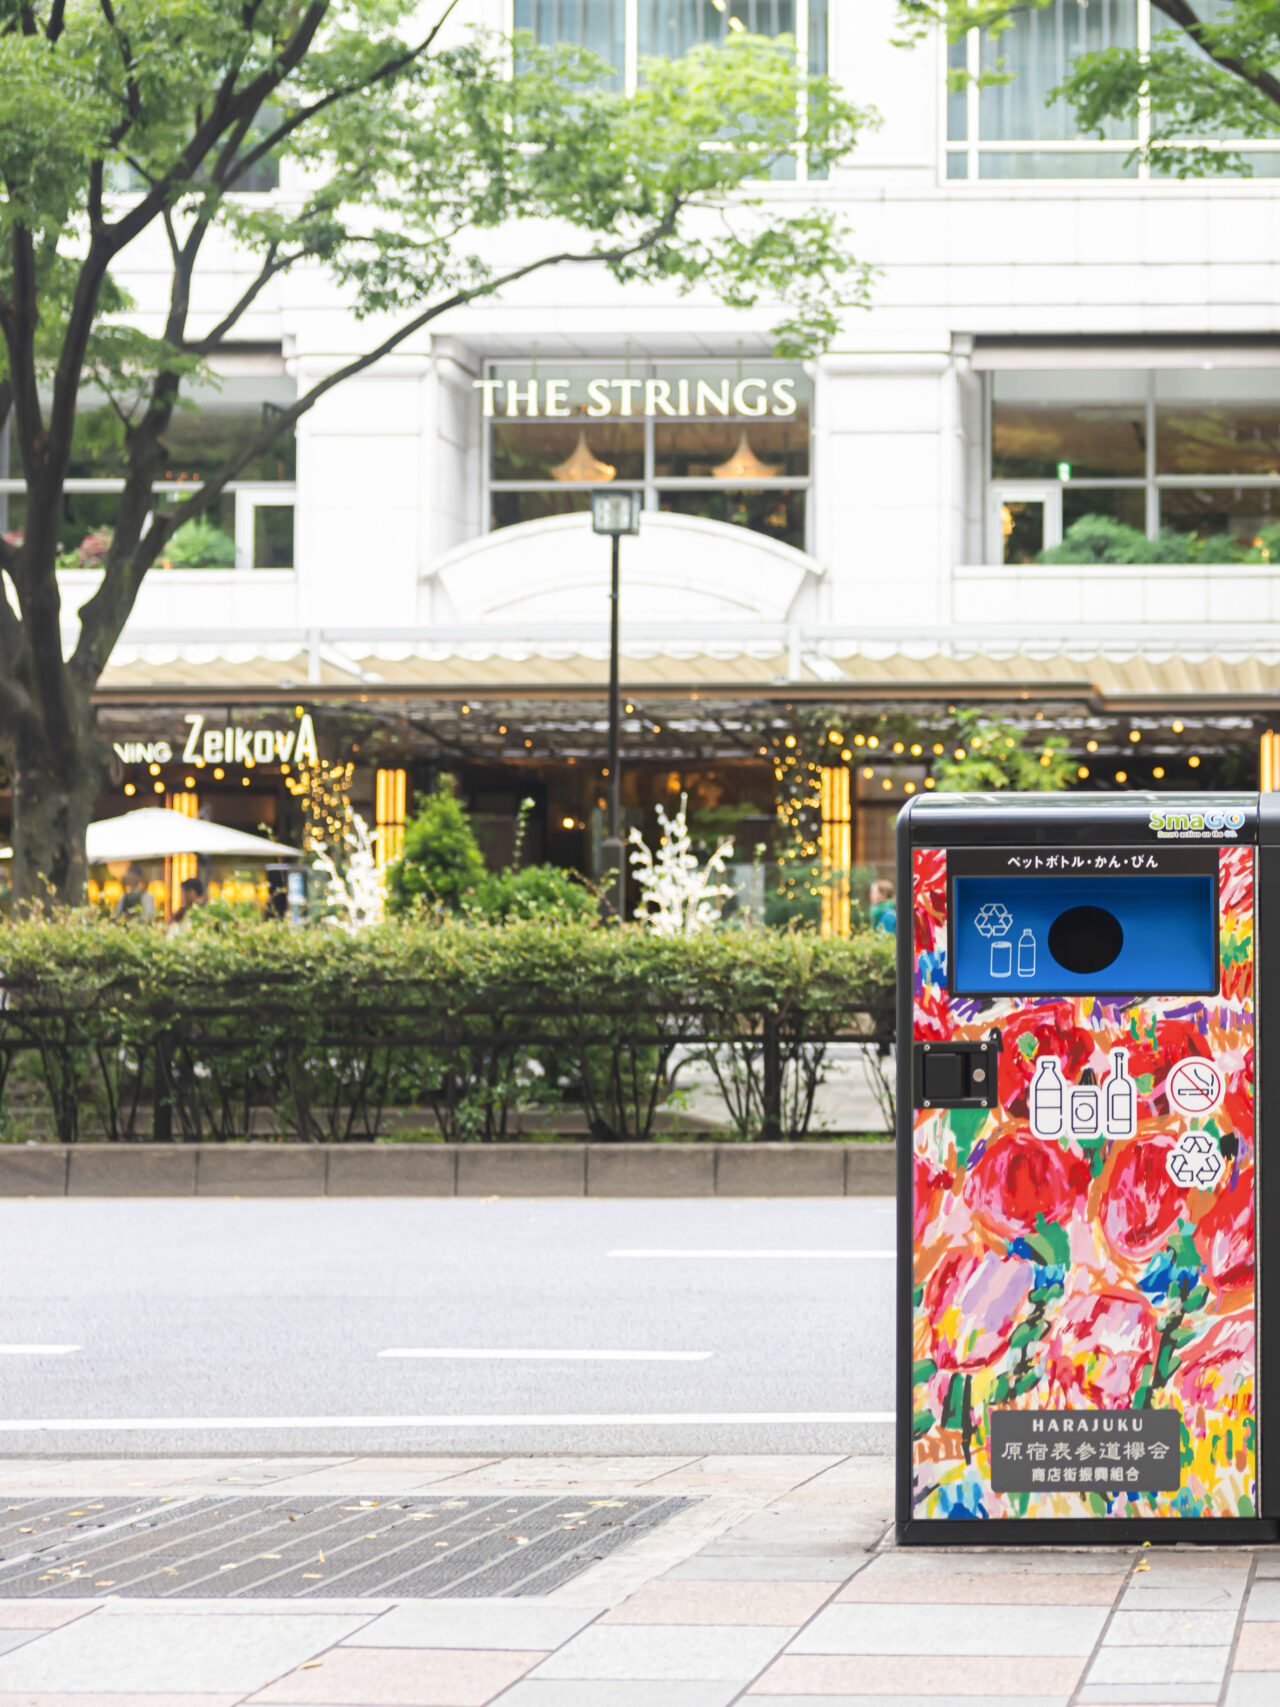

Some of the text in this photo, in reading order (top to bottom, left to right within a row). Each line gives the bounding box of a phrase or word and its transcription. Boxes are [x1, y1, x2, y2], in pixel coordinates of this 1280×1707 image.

[472, 378, 797, 417] THE STRINGS
[1149, 810, 1246, 830] SmaGO
[1032, 1418, 1143, 1432] HARAJUKU
[1032, 1466, 1140, 1482] 商店街振興組合
